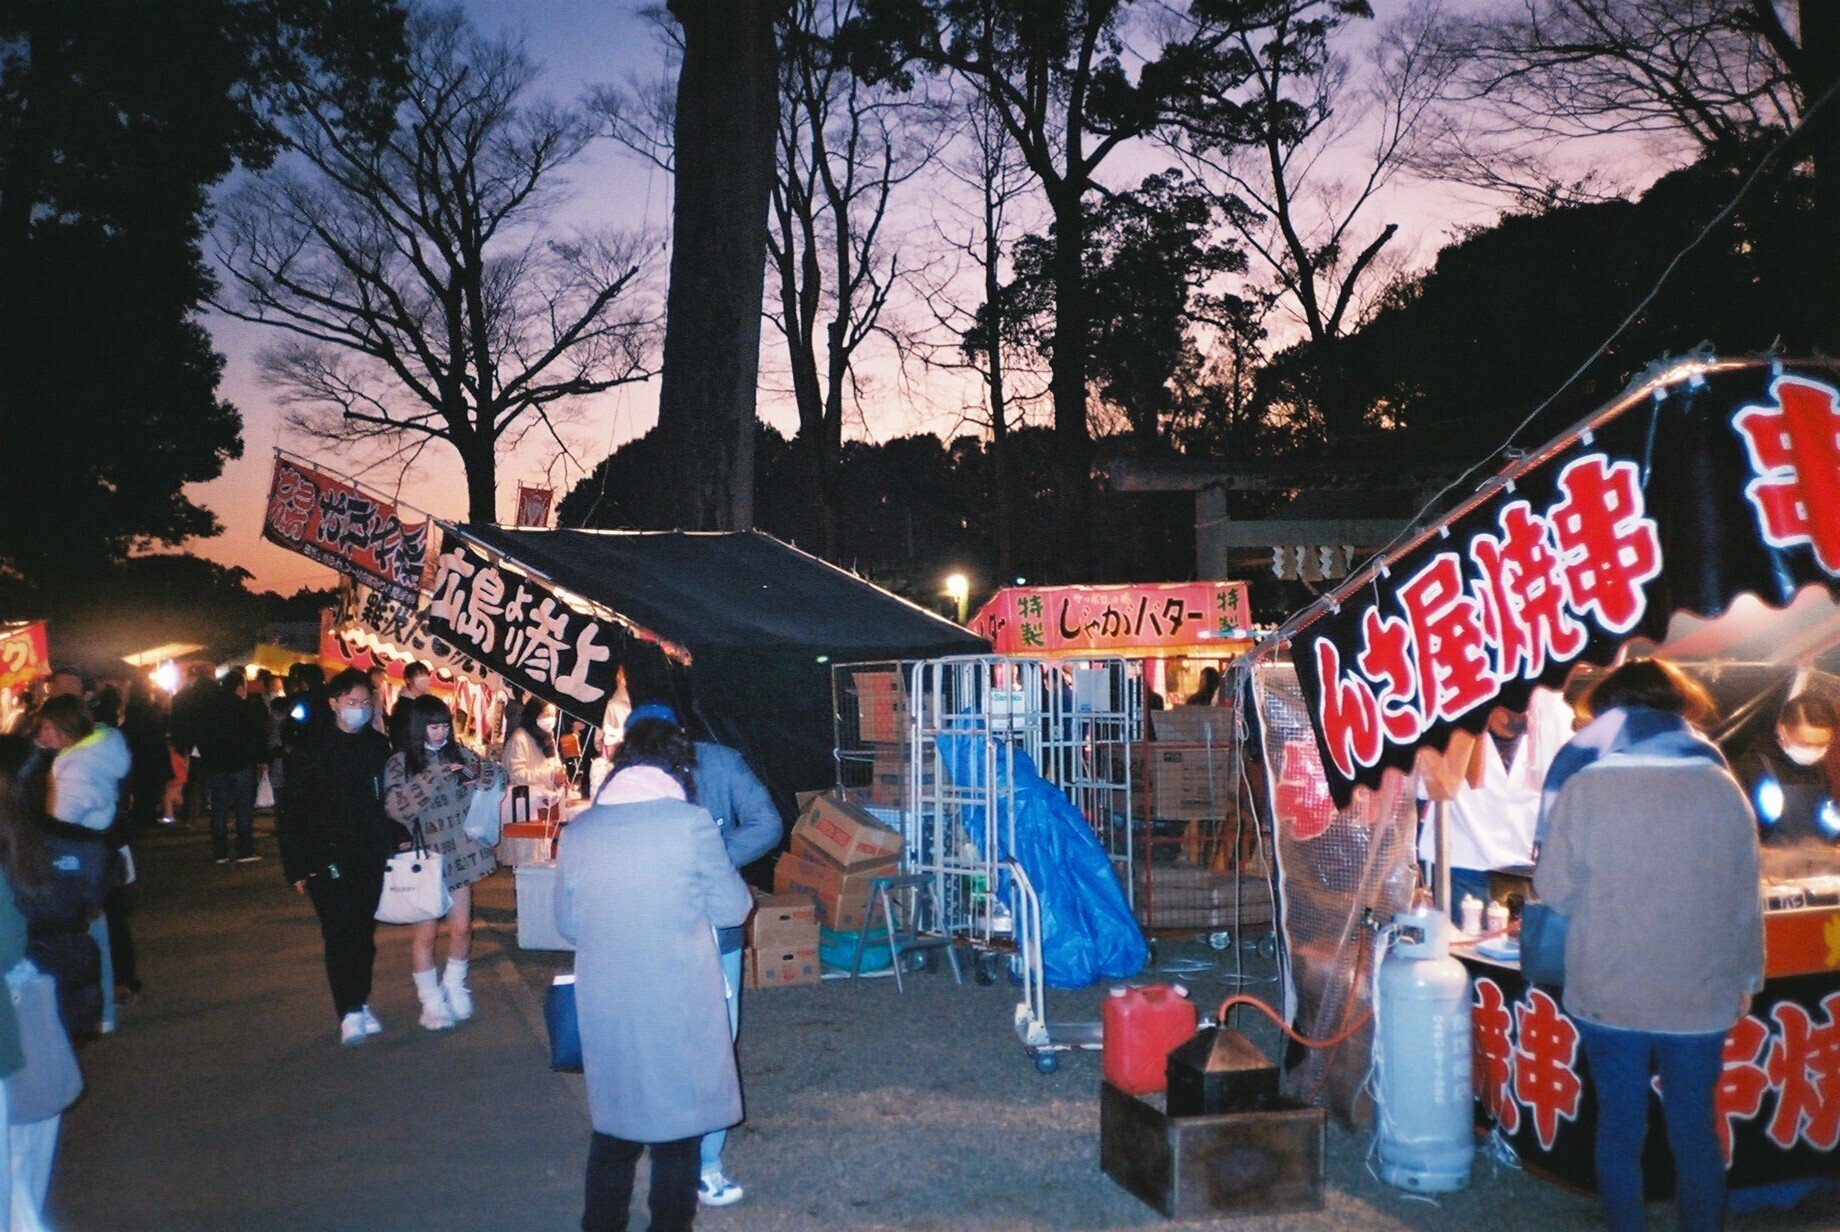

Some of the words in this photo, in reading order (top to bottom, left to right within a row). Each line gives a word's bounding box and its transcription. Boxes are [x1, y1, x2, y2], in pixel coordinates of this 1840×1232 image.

[1017, 594, 1045, 647] 特製
[1059, 596, 1203, 640] じゃがバター
